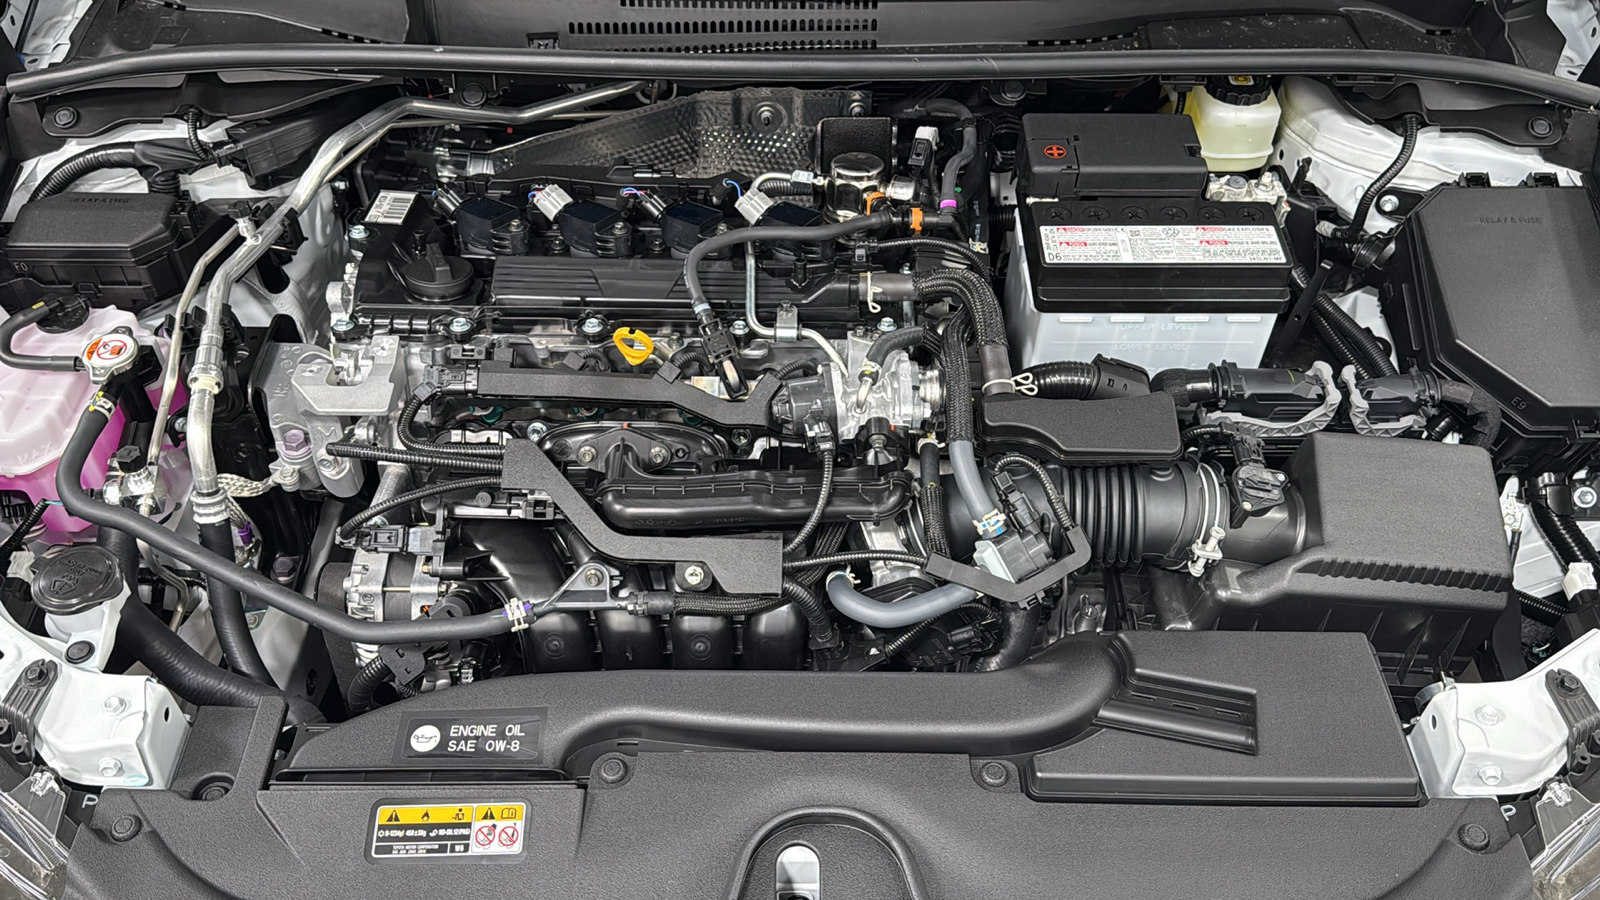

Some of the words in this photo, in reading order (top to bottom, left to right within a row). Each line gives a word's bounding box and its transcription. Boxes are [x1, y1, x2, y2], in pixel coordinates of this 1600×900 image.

[1479, 216, 1508, 224] RELAY
[1048, 252, 1062, 261] D6
[450, 725, 498, 736] ENGINE
[505, 724, 525, 736] OIL
[447, 740, 476, 752] SAE
[82, 794, 98, 808] P
[1500, 805, 1516, 821] P
